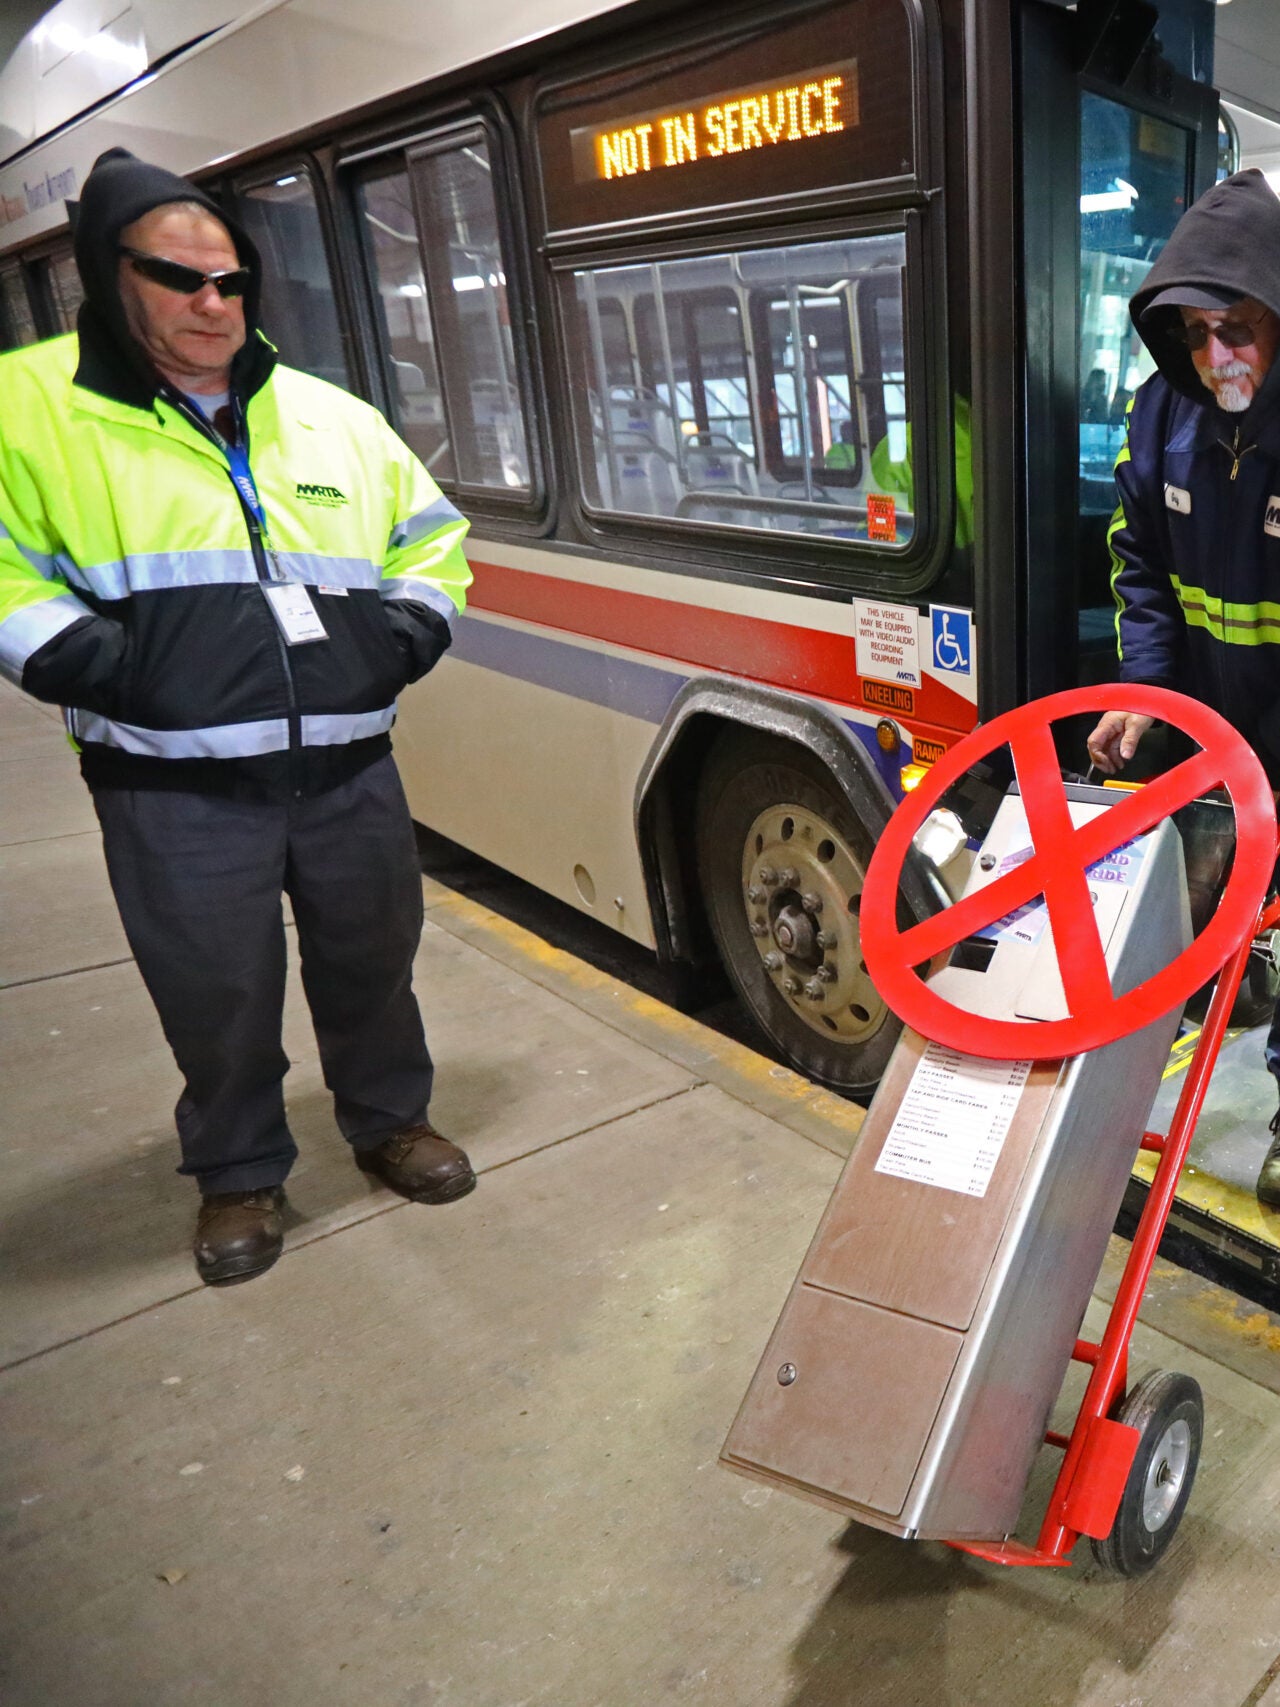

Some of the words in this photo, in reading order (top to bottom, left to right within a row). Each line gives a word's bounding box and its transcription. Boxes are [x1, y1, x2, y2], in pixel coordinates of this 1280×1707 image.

[600, 123, 652, 179] NOT
[661, 112, 698, 167] IN
[704, 76, 844, 157] SERVICE
[867, 607, 880, 617] THIS
[881, 610, 905, 622] VEHICLE
[859, 628, 875, 639] WITH
[860, 617, 874, 627] MAY
[875, 620, 883, 629] BE
[884, 622, 913, 634] EQUIPPED
[870, 641, 904, 656] RECORDING
[871, 652, 904, 666] EQUIPMENT
[863, 681, 912, 710] KNEELING
[914, 738, 945, 762] RAMP
